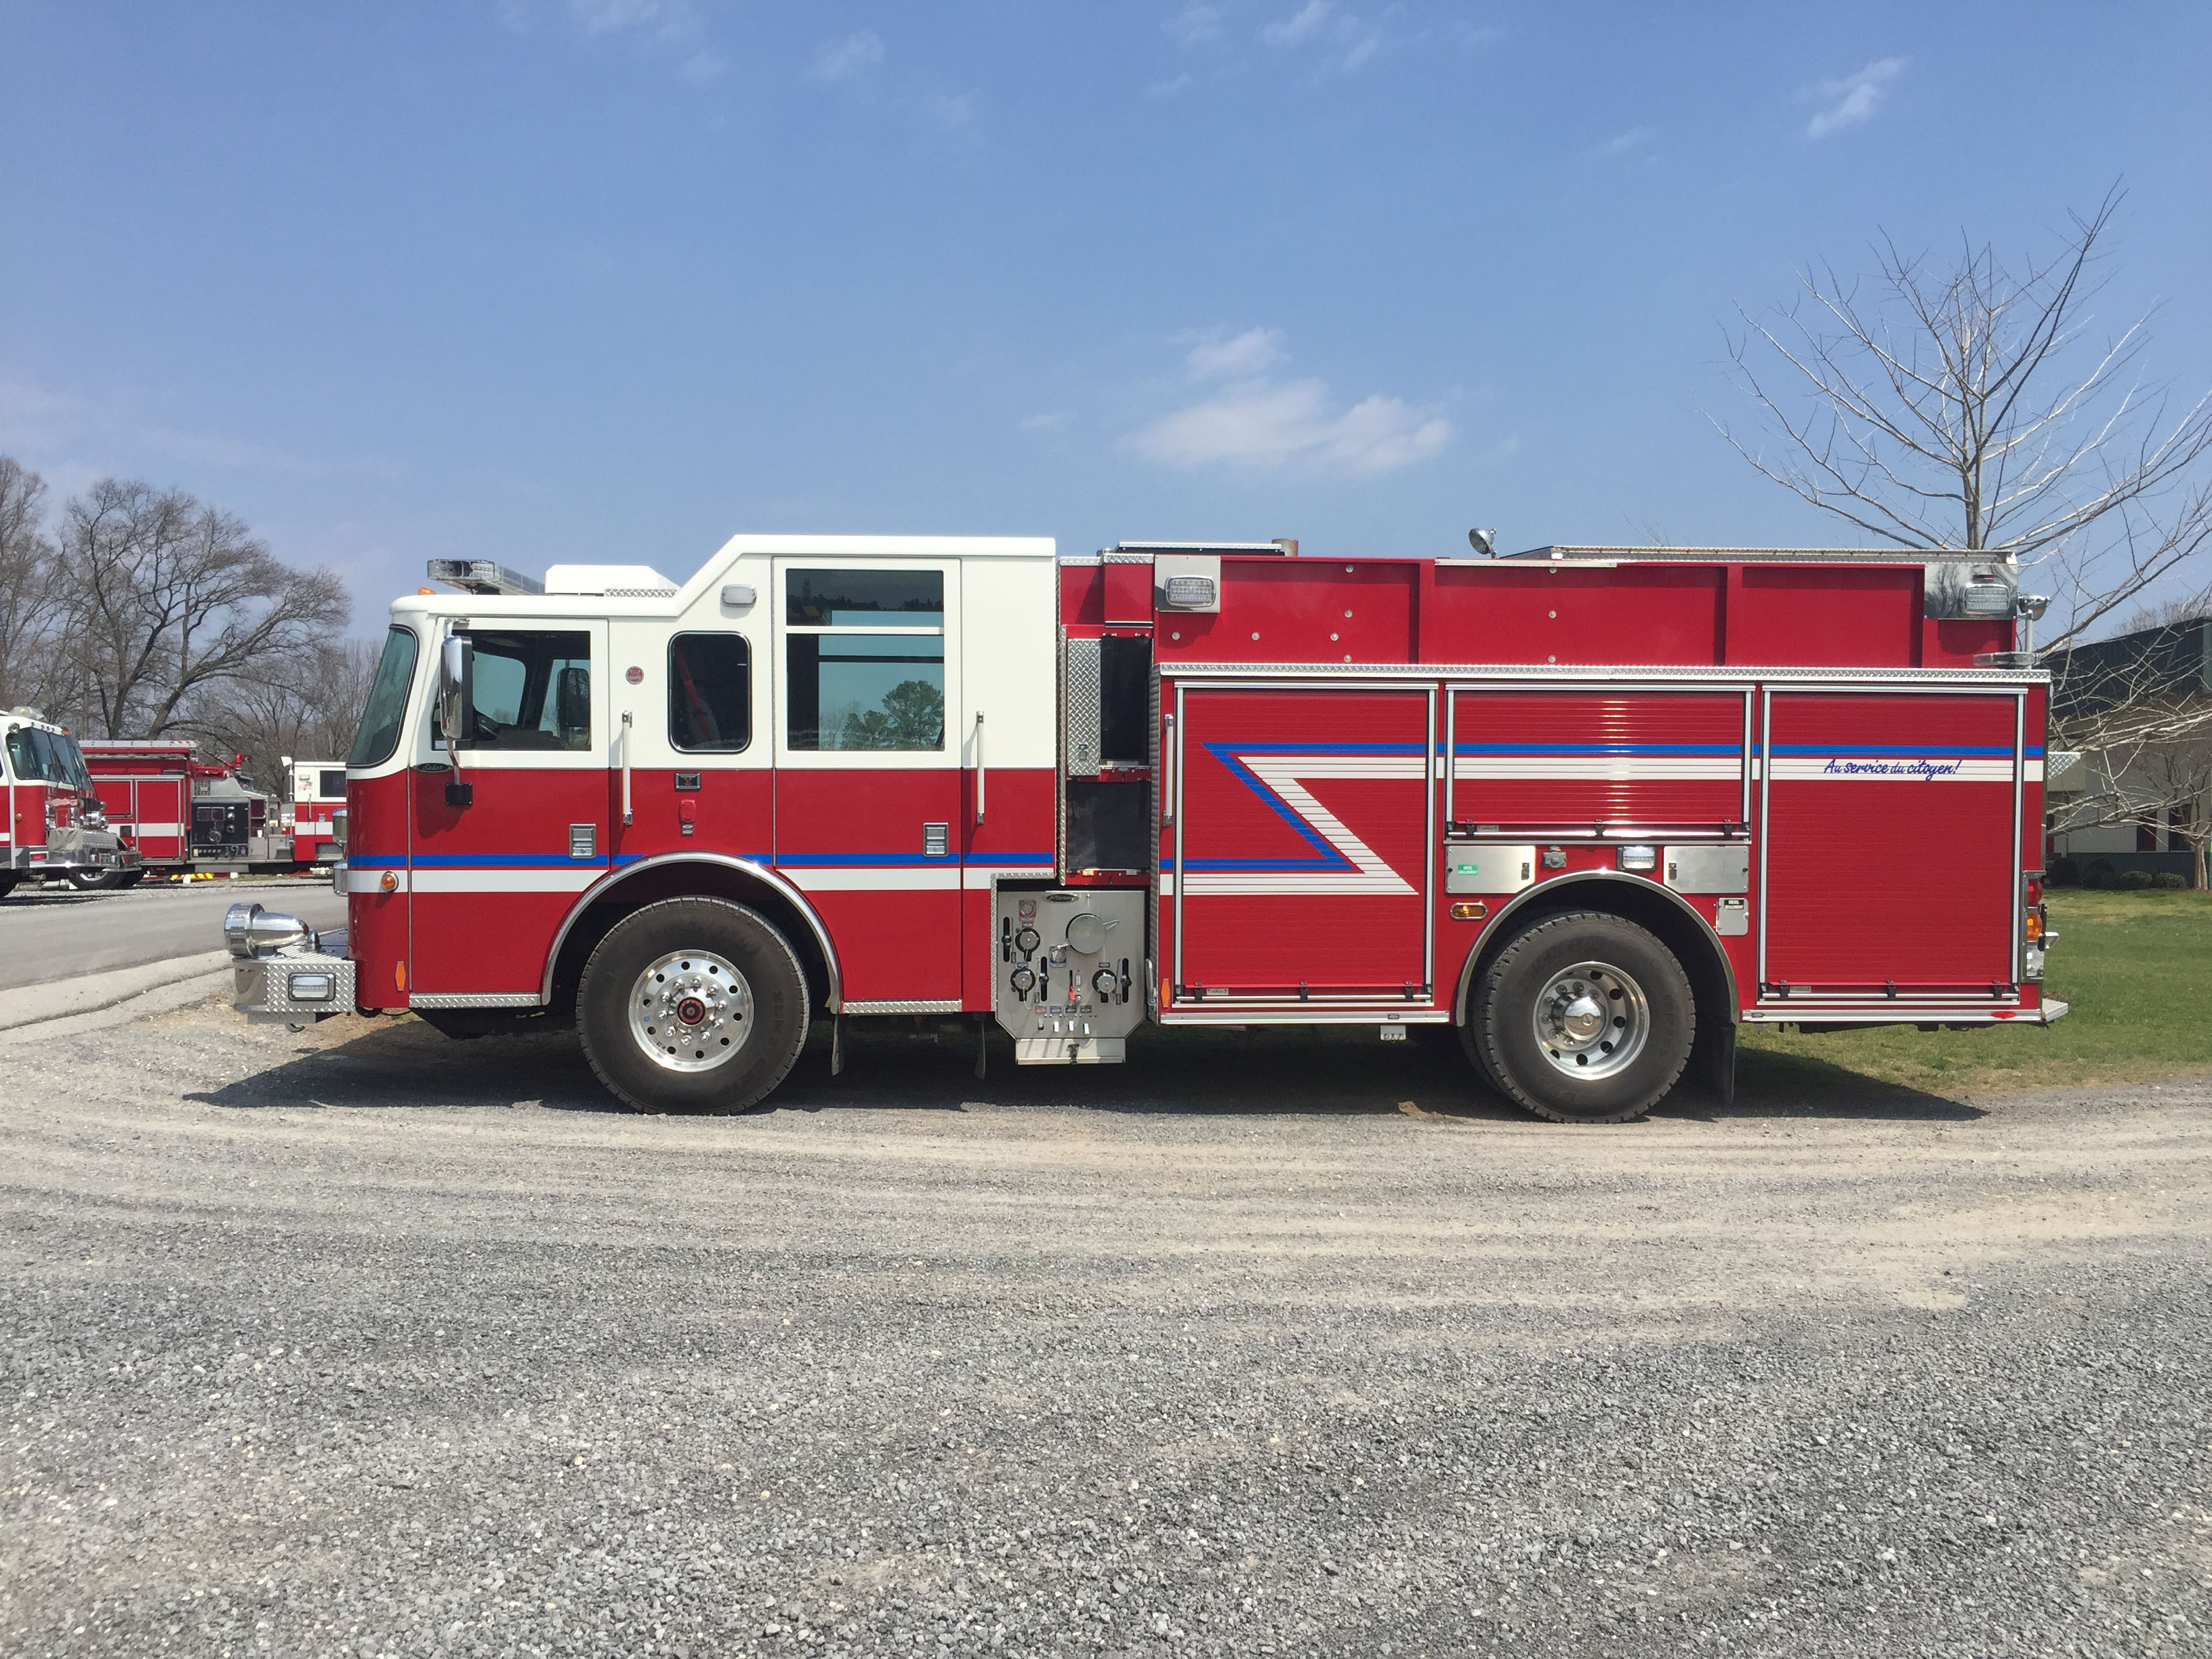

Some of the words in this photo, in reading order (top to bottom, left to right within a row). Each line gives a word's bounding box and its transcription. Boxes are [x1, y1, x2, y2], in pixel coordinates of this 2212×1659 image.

[1823, 758, 1841, 774] Au
[1843, 760, 1889, 774] service
[1890, 761, 1905, 774] du
[1906, 758, 1963, 781] citoyen!
